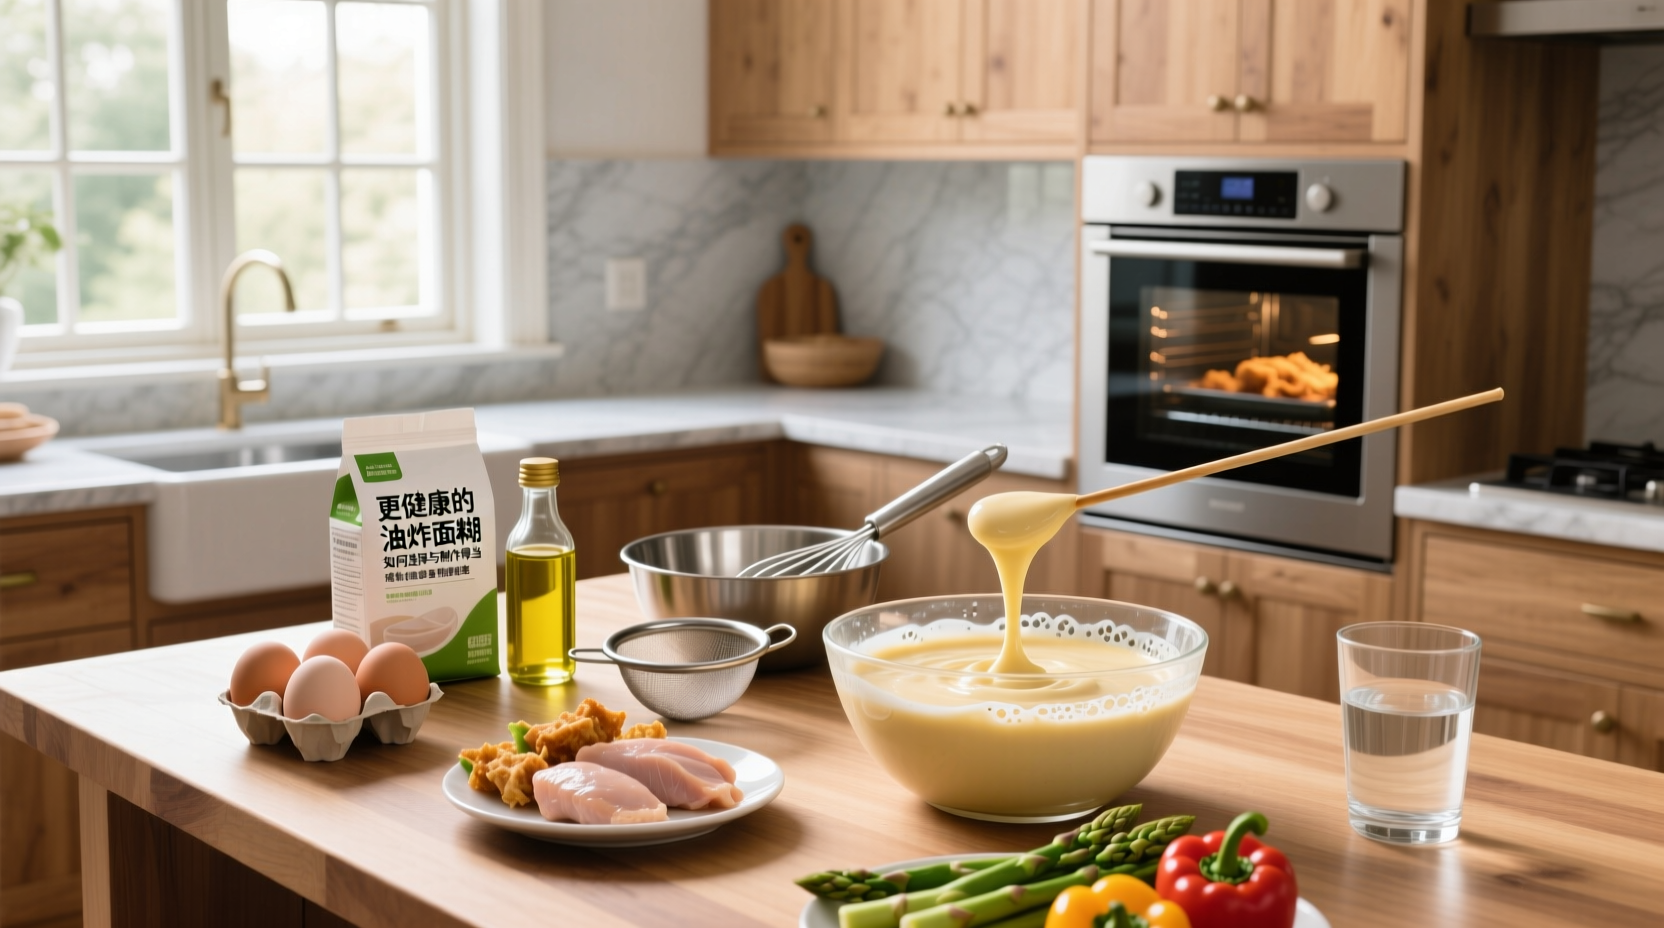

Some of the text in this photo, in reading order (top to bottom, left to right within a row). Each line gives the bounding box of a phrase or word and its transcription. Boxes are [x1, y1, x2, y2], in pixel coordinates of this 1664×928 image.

[376, 487, 474, 521] 更健康的
[380, 517, 481, 552] 油炸面糊
